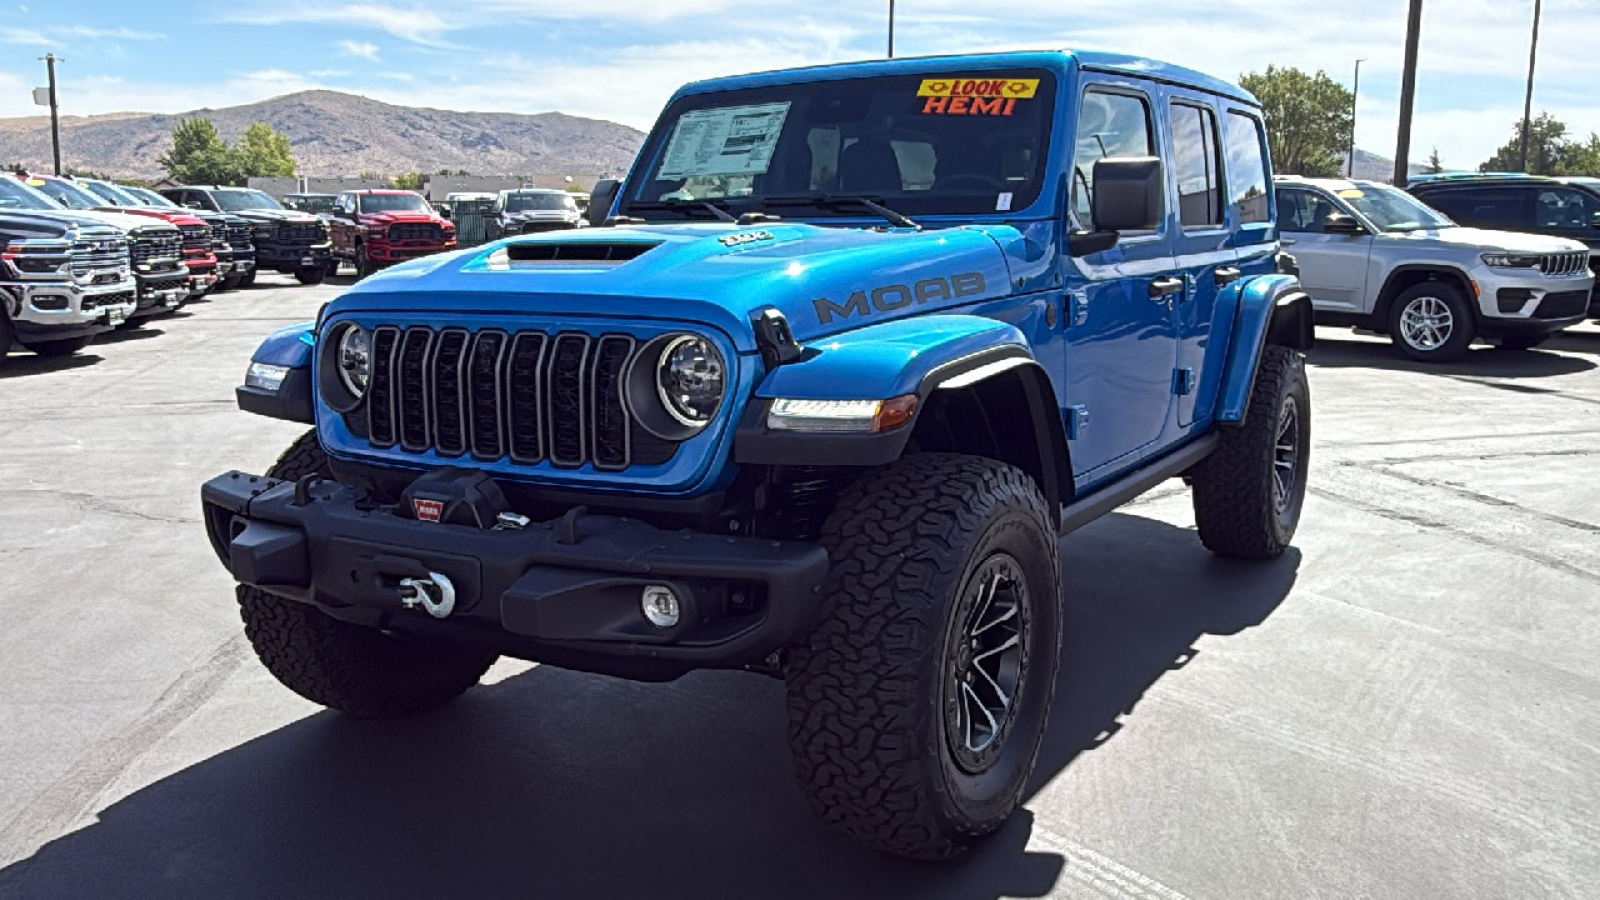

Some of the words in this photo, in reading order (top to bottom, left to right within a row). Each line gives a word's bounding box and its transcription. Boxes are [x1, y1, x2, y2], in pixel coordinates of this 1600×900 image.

[949, 80, 1007, 96] LOOK
[922, 96, 1016, 115] HEMI
[812, 272, 986, 324] MOAB
